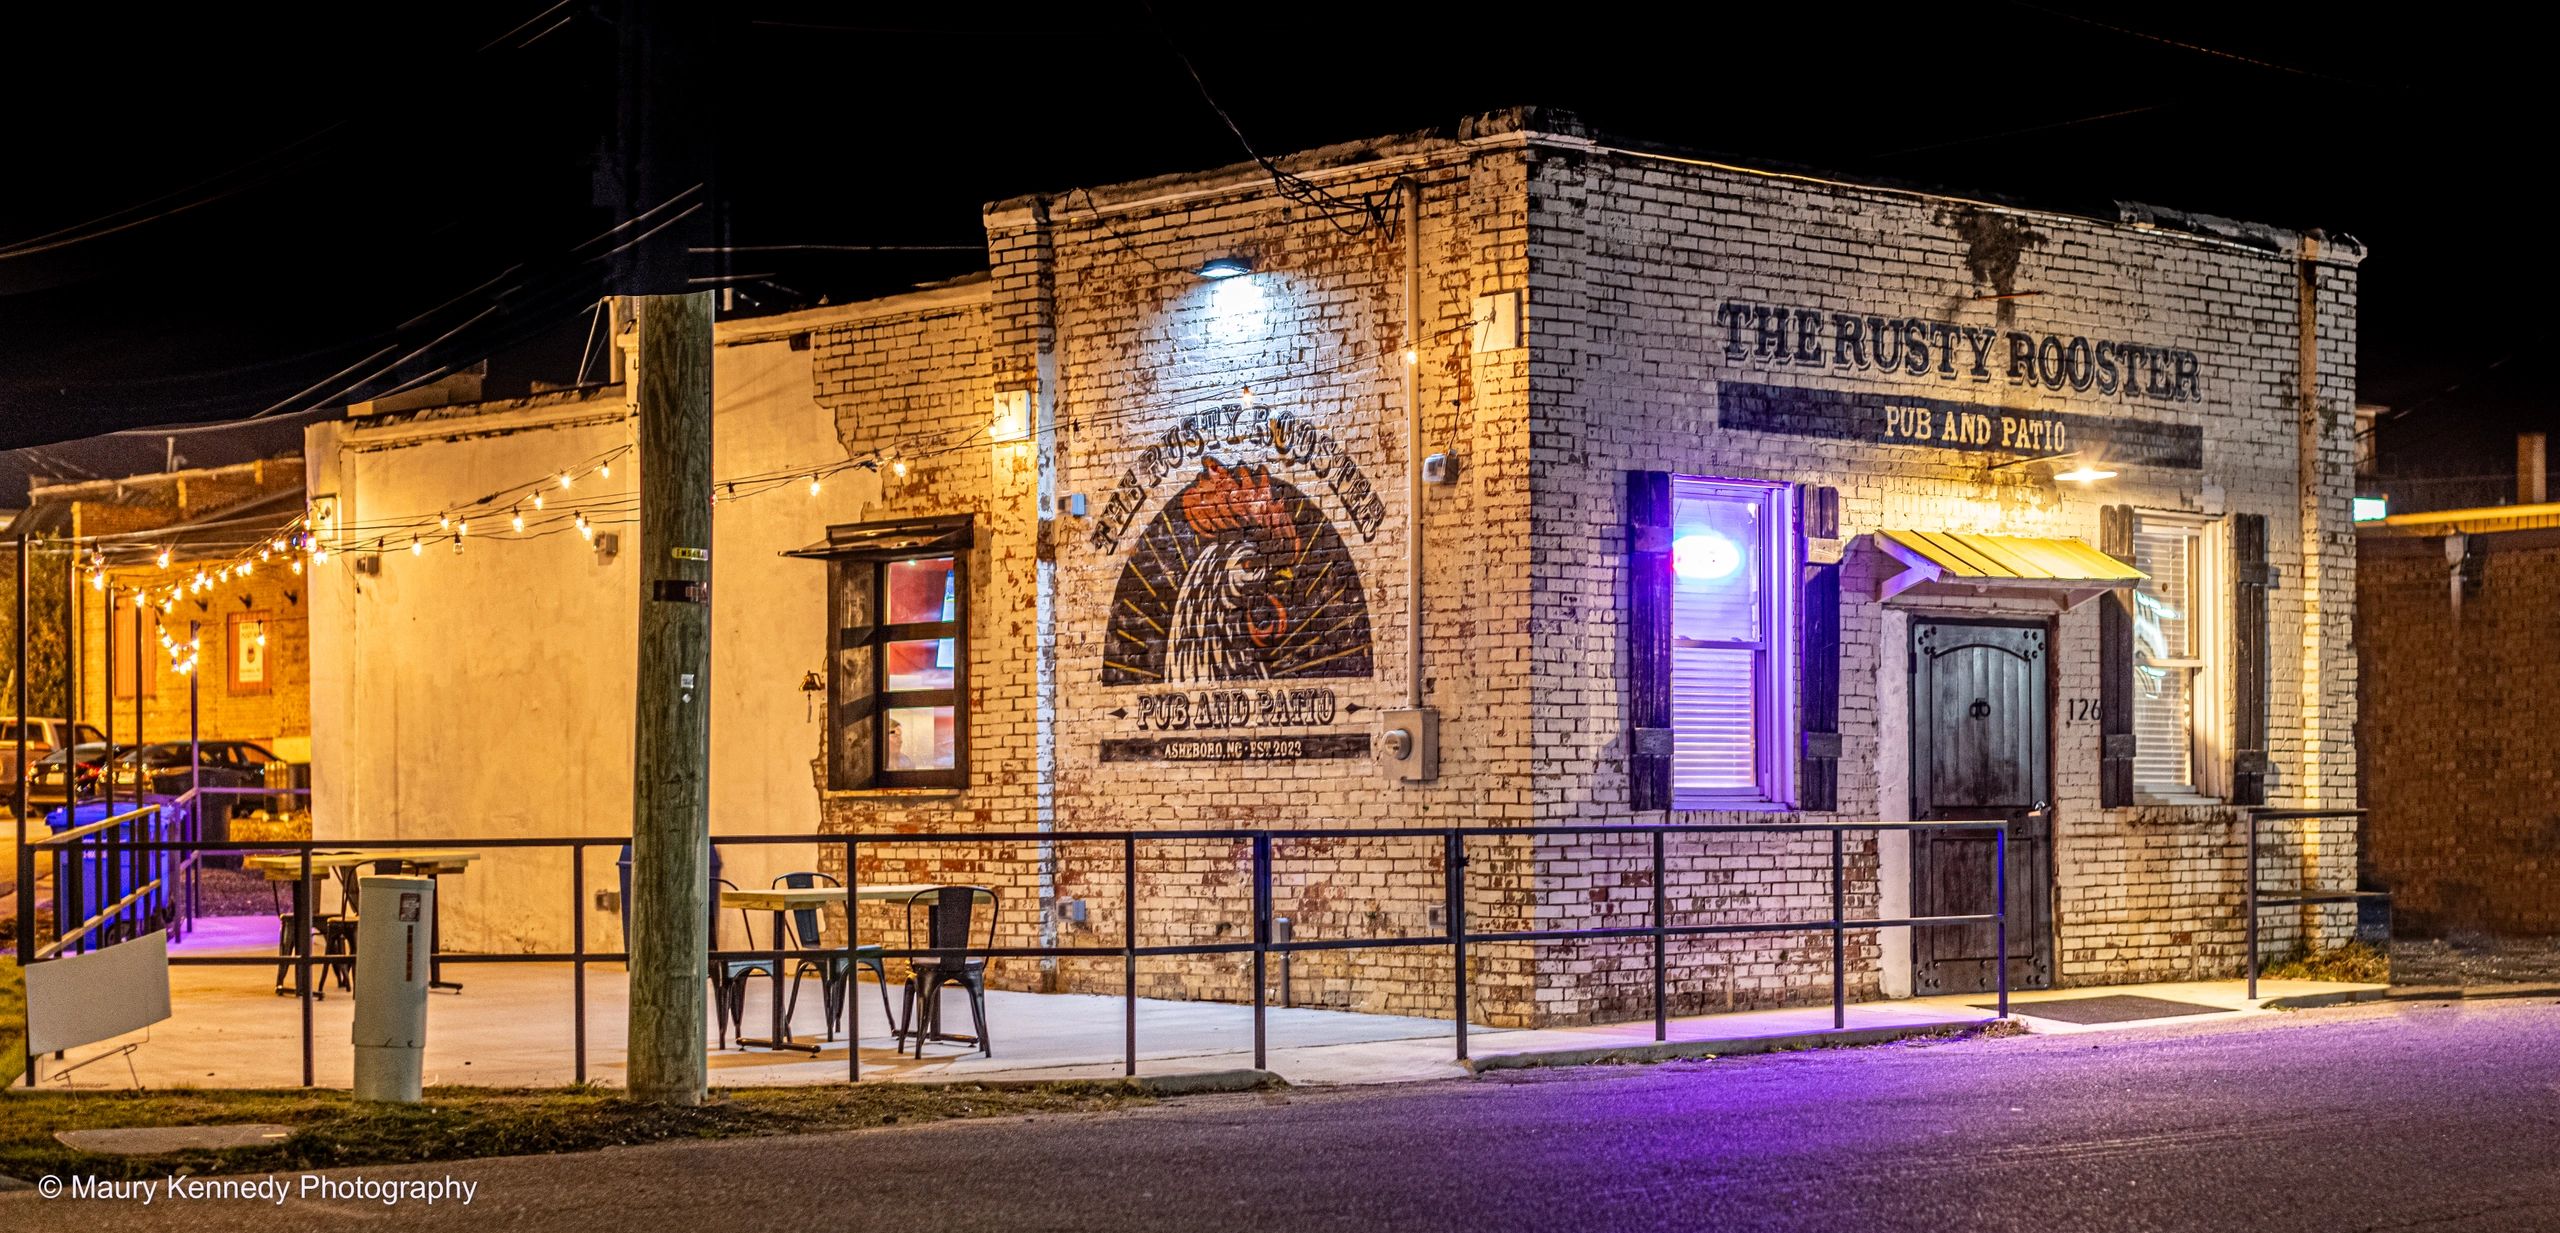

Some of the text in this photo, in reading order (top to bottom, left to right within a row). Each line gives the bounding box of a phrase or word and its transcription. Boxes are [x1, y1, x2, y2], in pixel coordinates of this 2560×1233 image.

[1716, 303, 2202, 401] THE RUSTY ROOSTER
[1884, 405, 2066, 453] PUB AND PATIO
[1090, 403, 1387, 555] THE RUSTY ROOSTER
[1136, 688, 1336, 730] PUB AND PATIO
[2069, 698, 2101, 721] 126
